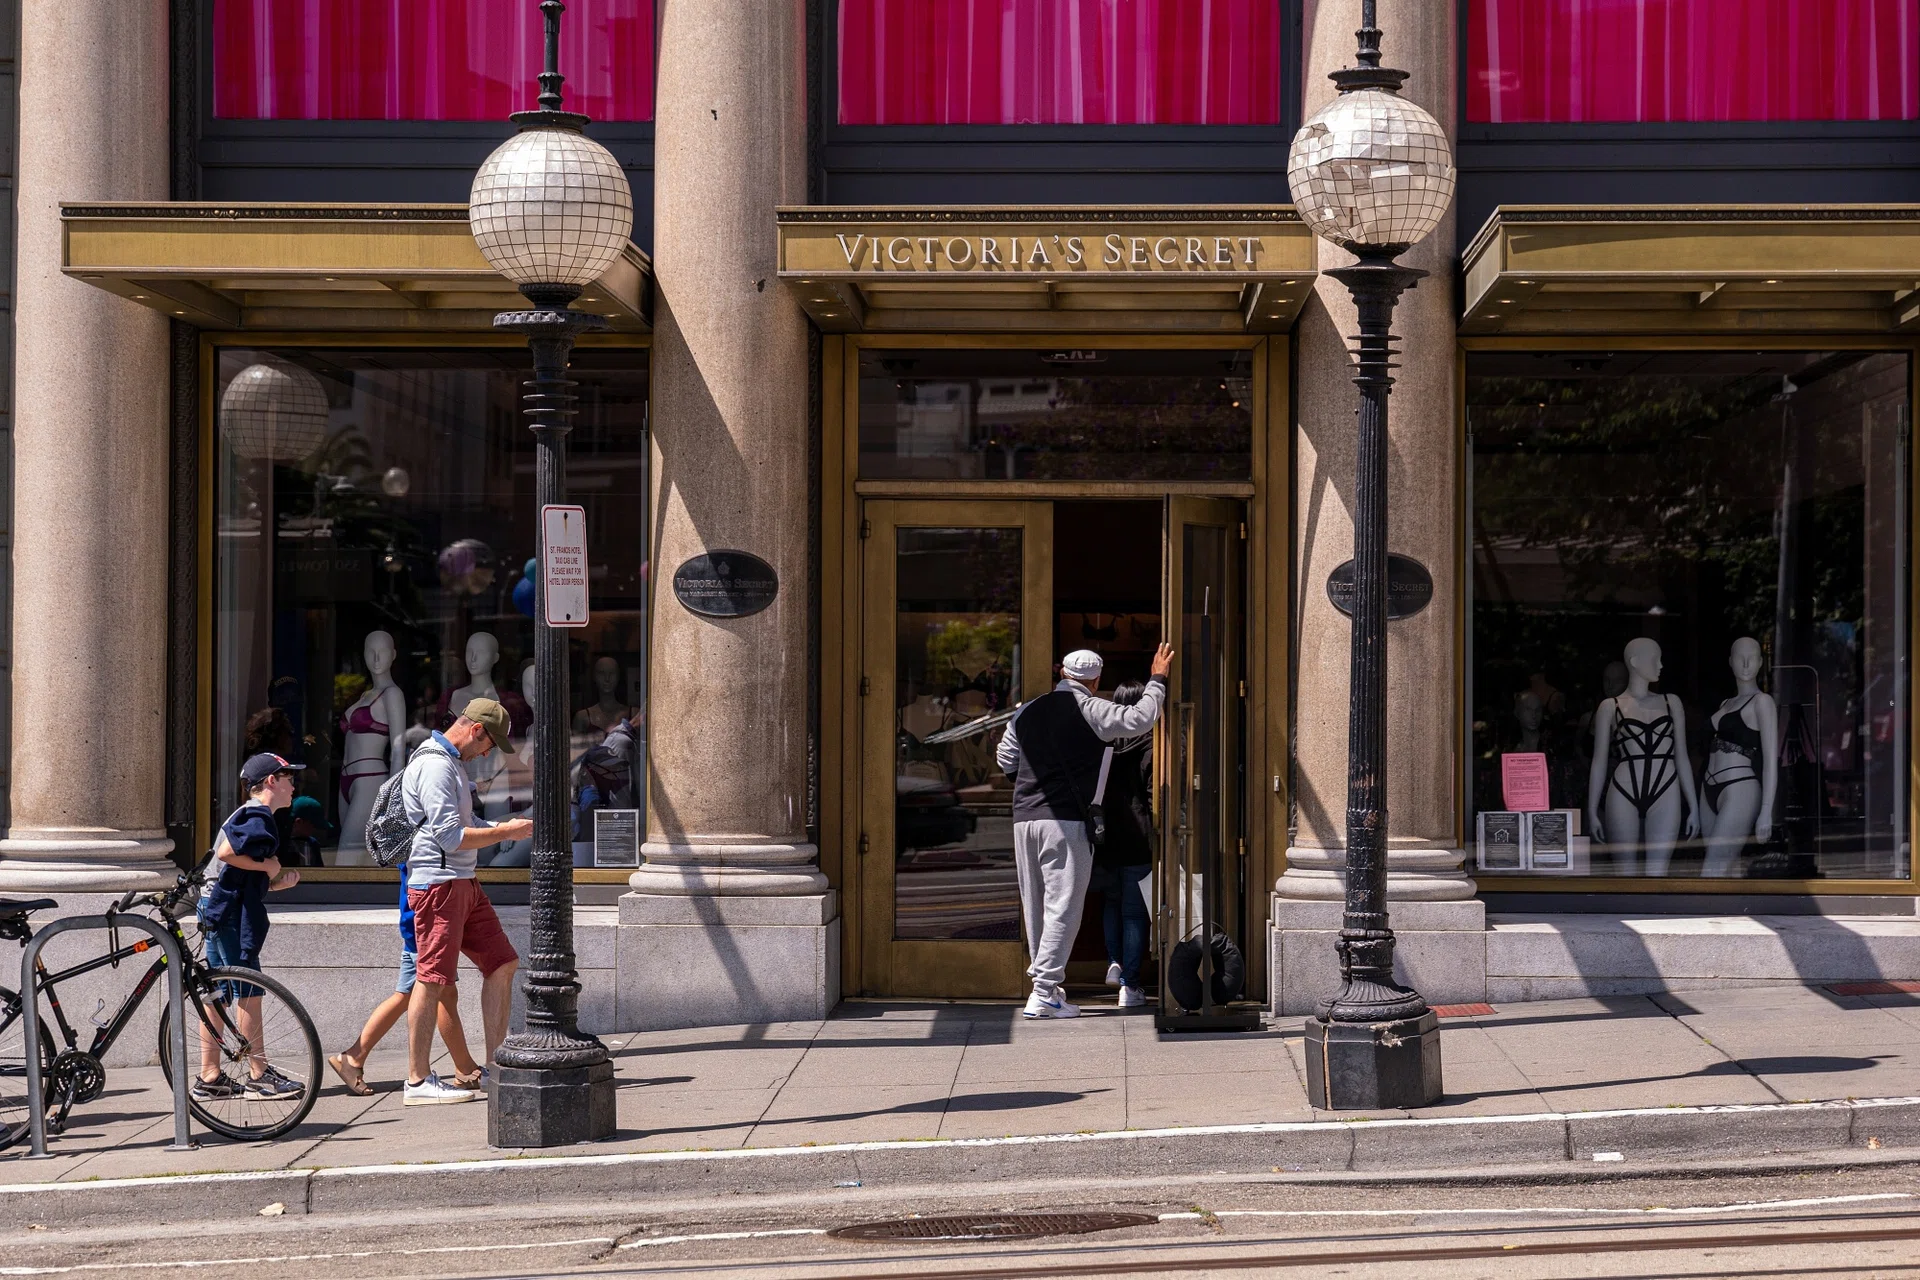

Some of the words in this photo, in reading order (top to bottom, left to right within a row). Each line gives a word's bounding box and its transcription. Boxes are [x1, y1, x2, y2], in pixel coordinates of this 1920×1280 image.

[836, 234, 1082, 264] VICTORIA'S
[1104, 233, 1259, 264] SECRET
[571, 546, 582, 555] HOTEL
[555, 556, 563, 564] TAXI
[551, 567, 566, 575] PLEASE
[566, 567, 574, 575] WAIT
[734, 578, 775, 589] SECRET
[1391, 581, 1429, 592] SECRET
[135, 970, 155, 996] MARIN
